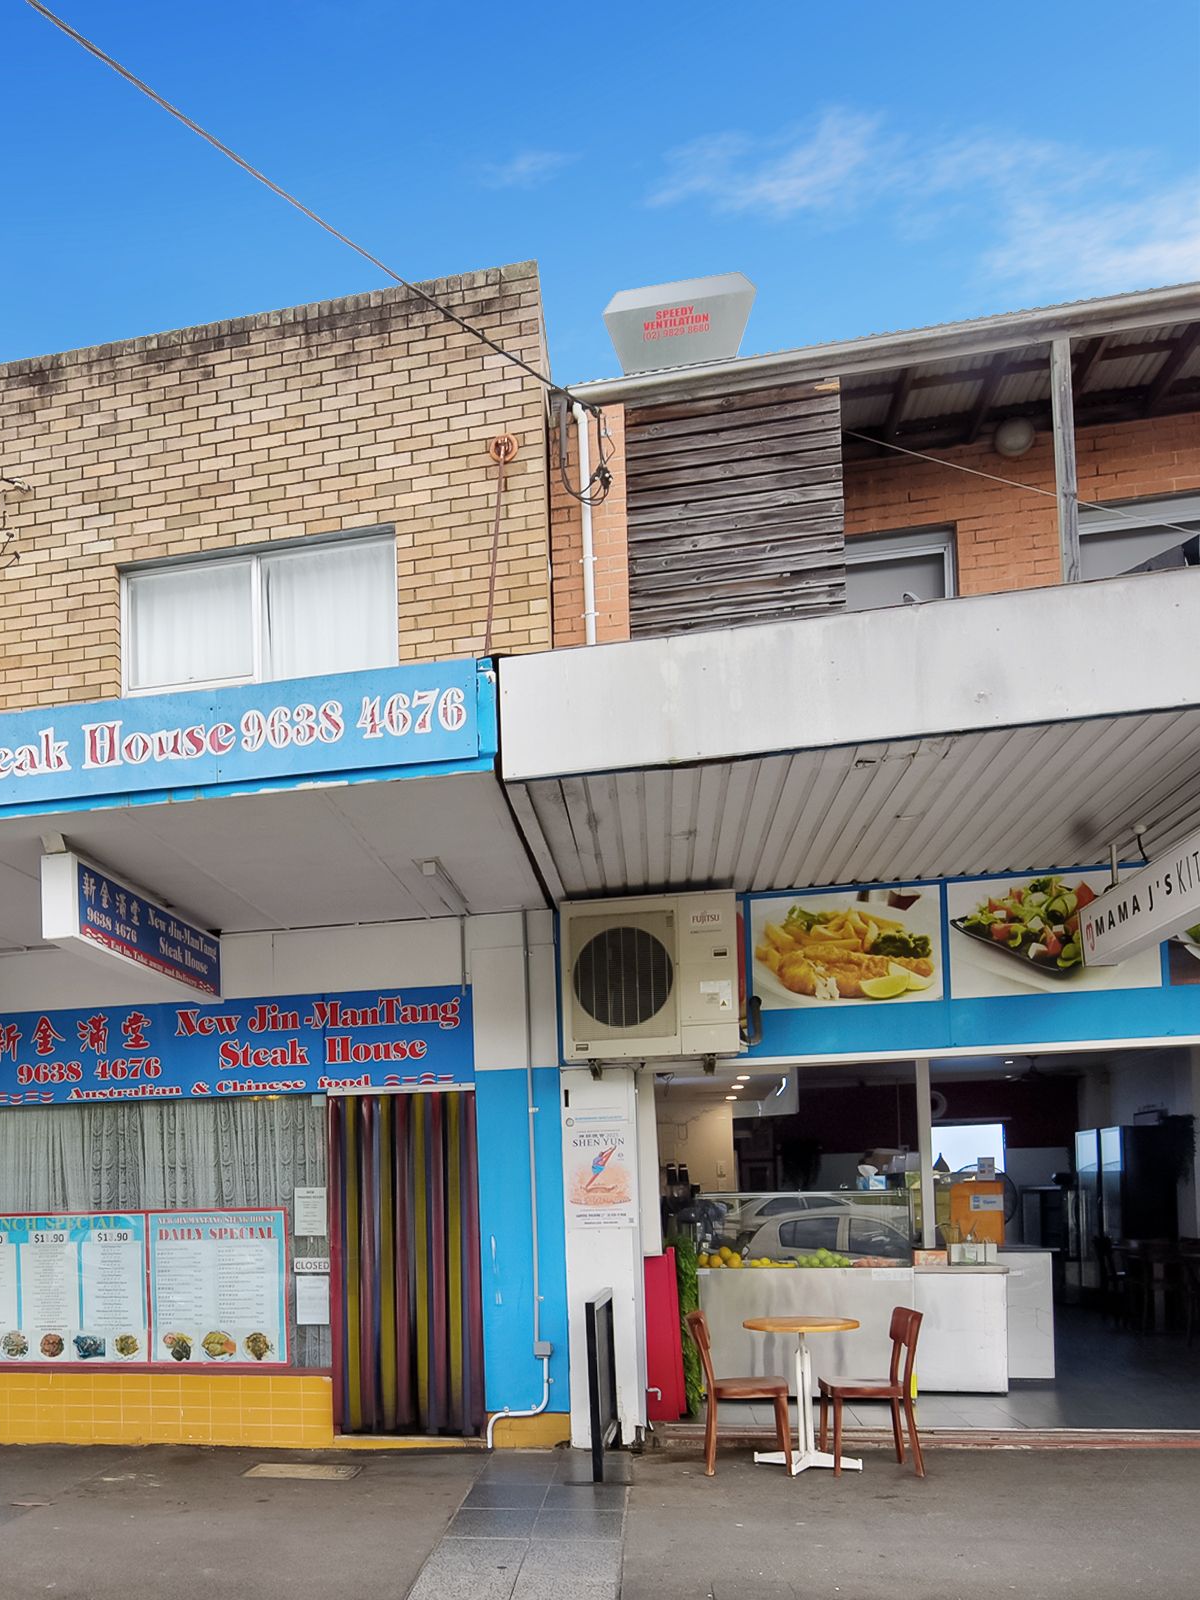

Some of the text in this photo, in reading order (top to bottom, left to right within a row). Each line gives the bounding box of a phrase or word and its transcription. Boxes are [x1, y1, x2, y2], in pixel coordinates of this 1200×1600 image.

[643, 313, 709, 331] VENTILATION
[655, 305, 695, 321] SPEEDY
[643, 331, 660, 343] (02)
[81, 720, 237, 770] House
[240, 699, 345, 752] 9638
[356, 686, 467, 739] 4676
[86, 907, 138, 944] 9638 4676
[148, 908, 166, 933] New
[691, 913, 720, 925] FUJITSU
[1094, 894, 1141, 937] MAMA
[133, 950, 148, 965] Take
[159, 936, 208, 975] Steak House
[175, 1009, 241, 1037] New
[218, 1035, 427, 1070] Steak House
[17, 1056, 162, 1085] 9638 4676
[66, 1074, 371, 1100] Australian & Chinese food
[572, 1137, 625, 1147] SHEN YUN
[45, 1215, 121, 1230] SPECIAL
[158, 1226, 277, 1241] DAILY SPECIAL
[295, 1261, 330, 1270] CLOSED
